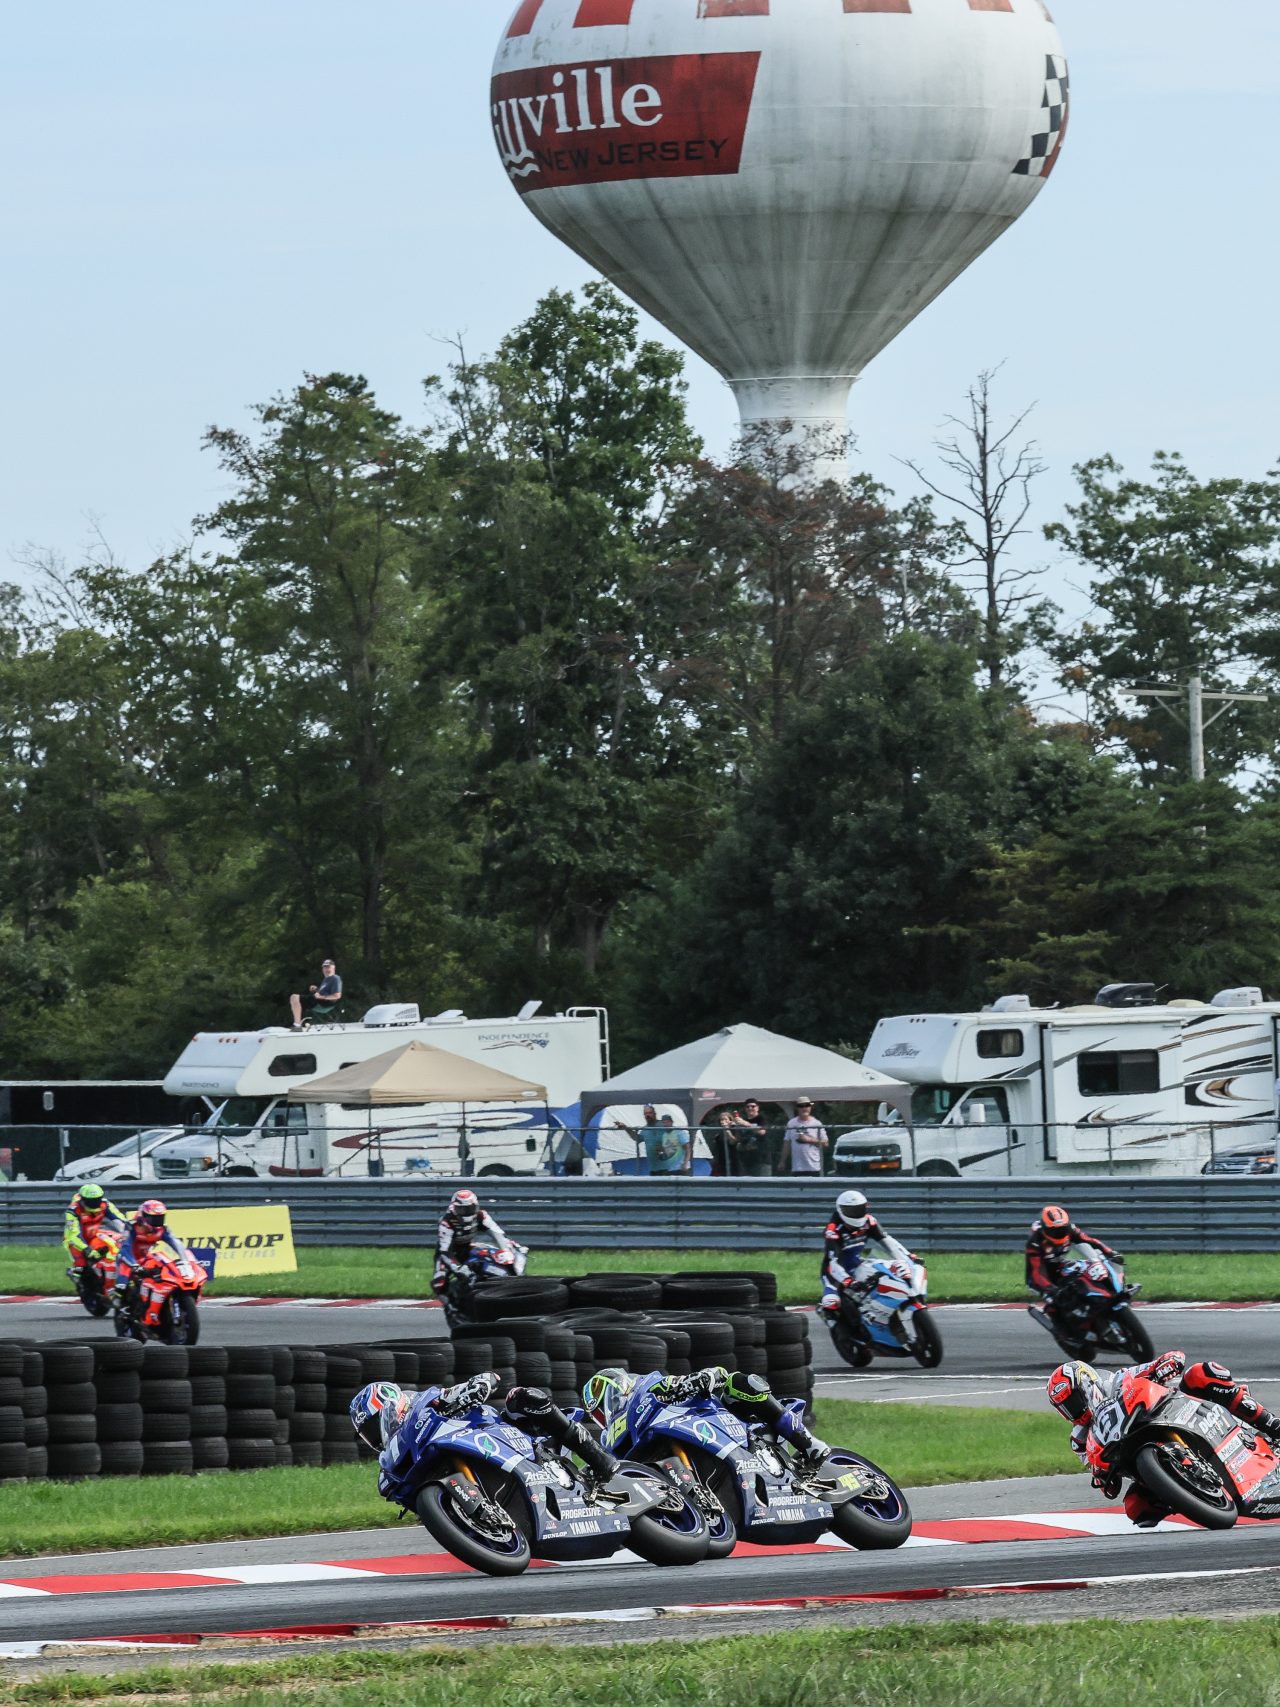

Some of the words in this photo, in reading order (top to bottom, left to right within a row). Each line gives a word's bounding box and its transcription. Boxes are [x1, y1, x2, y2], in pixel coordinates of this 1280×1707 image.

[493, 67, 663, 158] illville
[540, 148, 589, 171] NEW
[598, 138, 728, 165] JERSEY
[769, 1495, 807, 1507] PROGRESSIVE
[561, 1507, 601, 1520] PROGRESSIVE
[777, 1508, 805, 1521] YAMAHA
[569, 1520, 601, 1535] YAMAHA
[543, 1531, 567, 1540] DUNLOP
